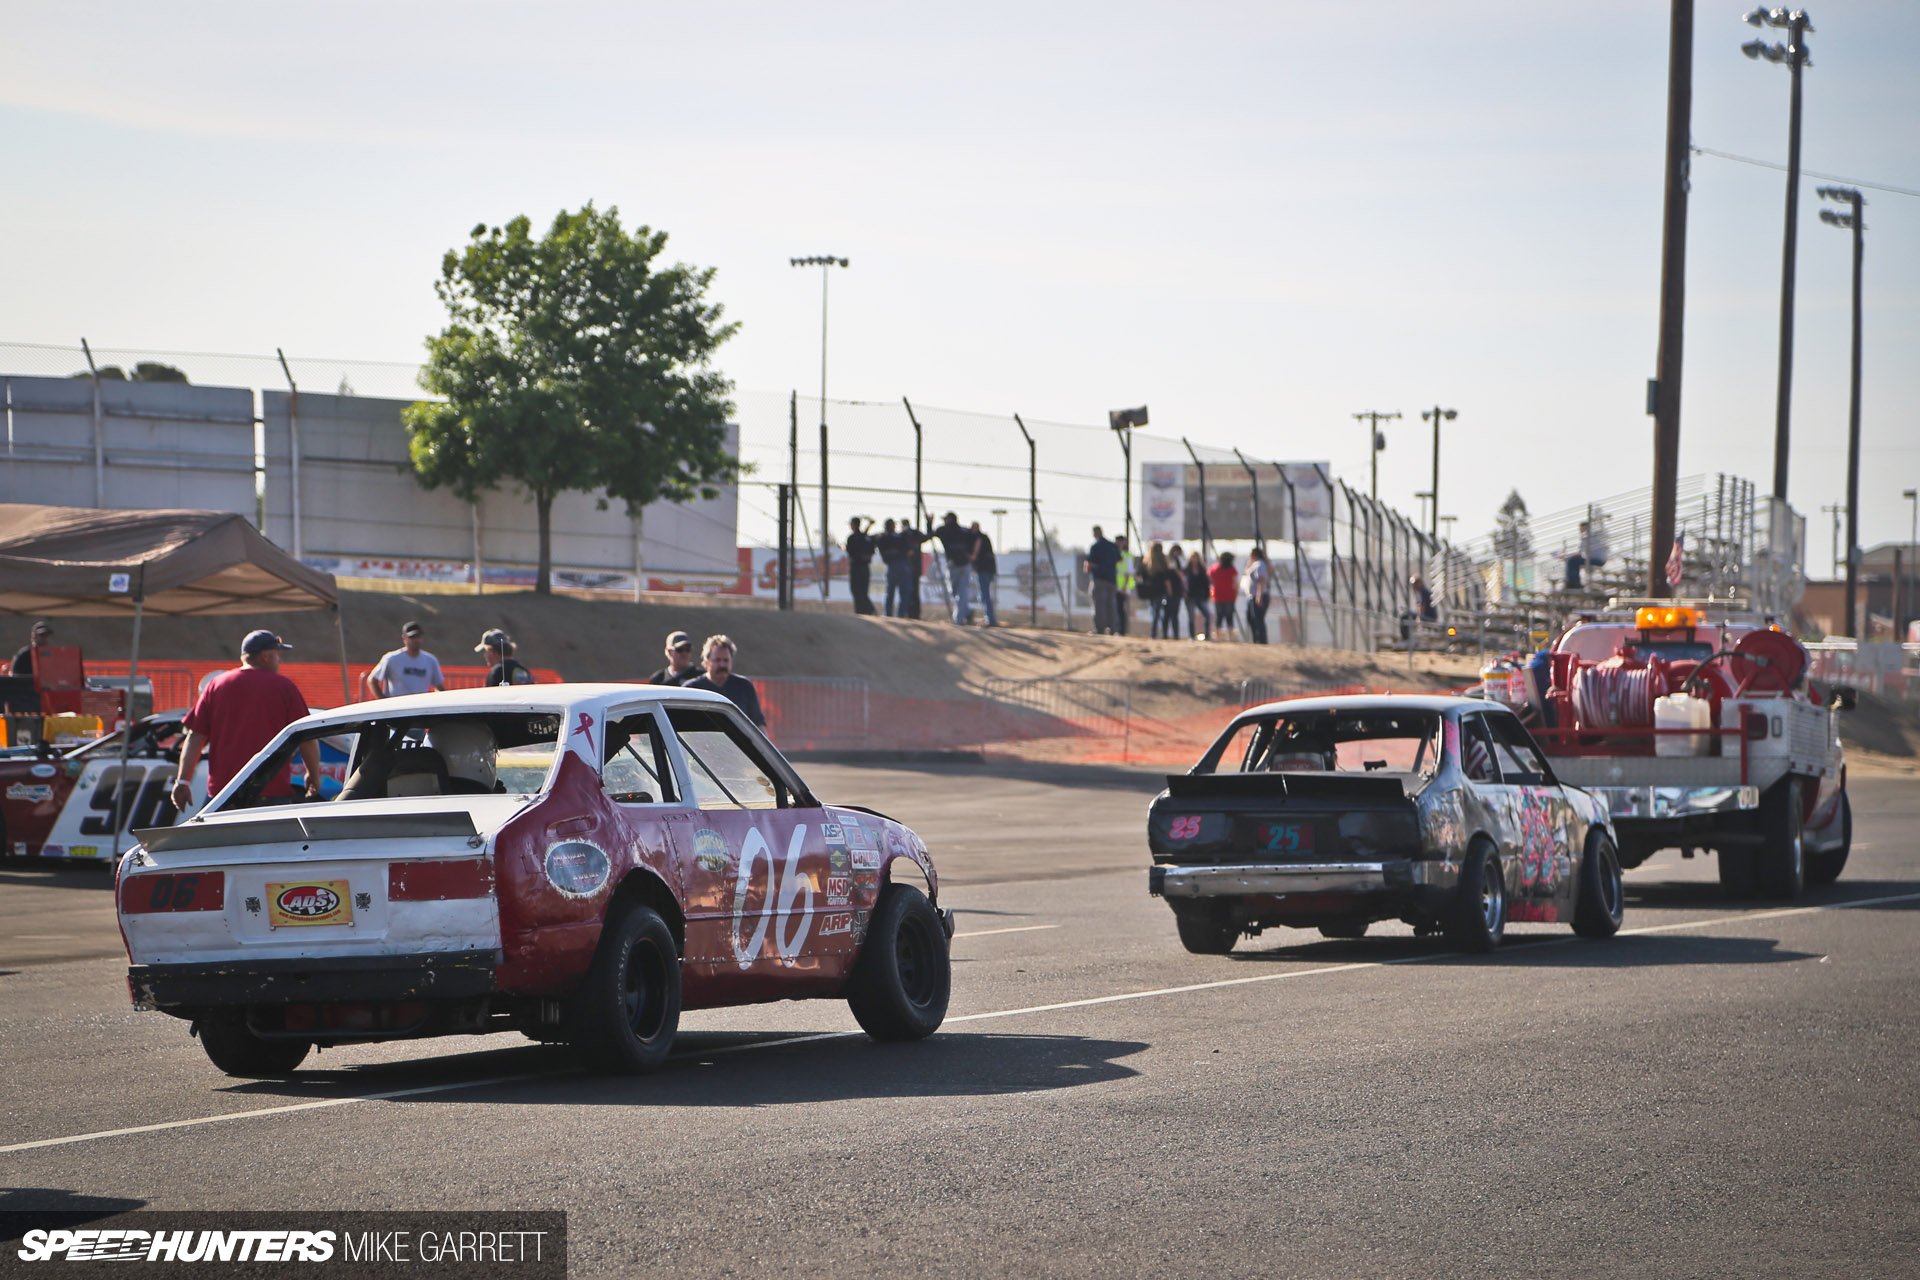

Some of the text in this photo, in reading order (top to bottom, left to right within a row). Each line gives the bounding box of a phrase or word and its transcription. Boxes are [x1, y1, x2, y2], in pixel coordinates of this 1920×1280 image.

[1169, 816, 1202, 839] 25
[1267, 825, 1301, 850] 25
[149, 876, 198, 909] 06
[732, 823, 815, 970] 06
[828, 879, 849, 896] MSD
[289, 893, 329, 908] ADS
[821, 913, 851, 932] ARP
